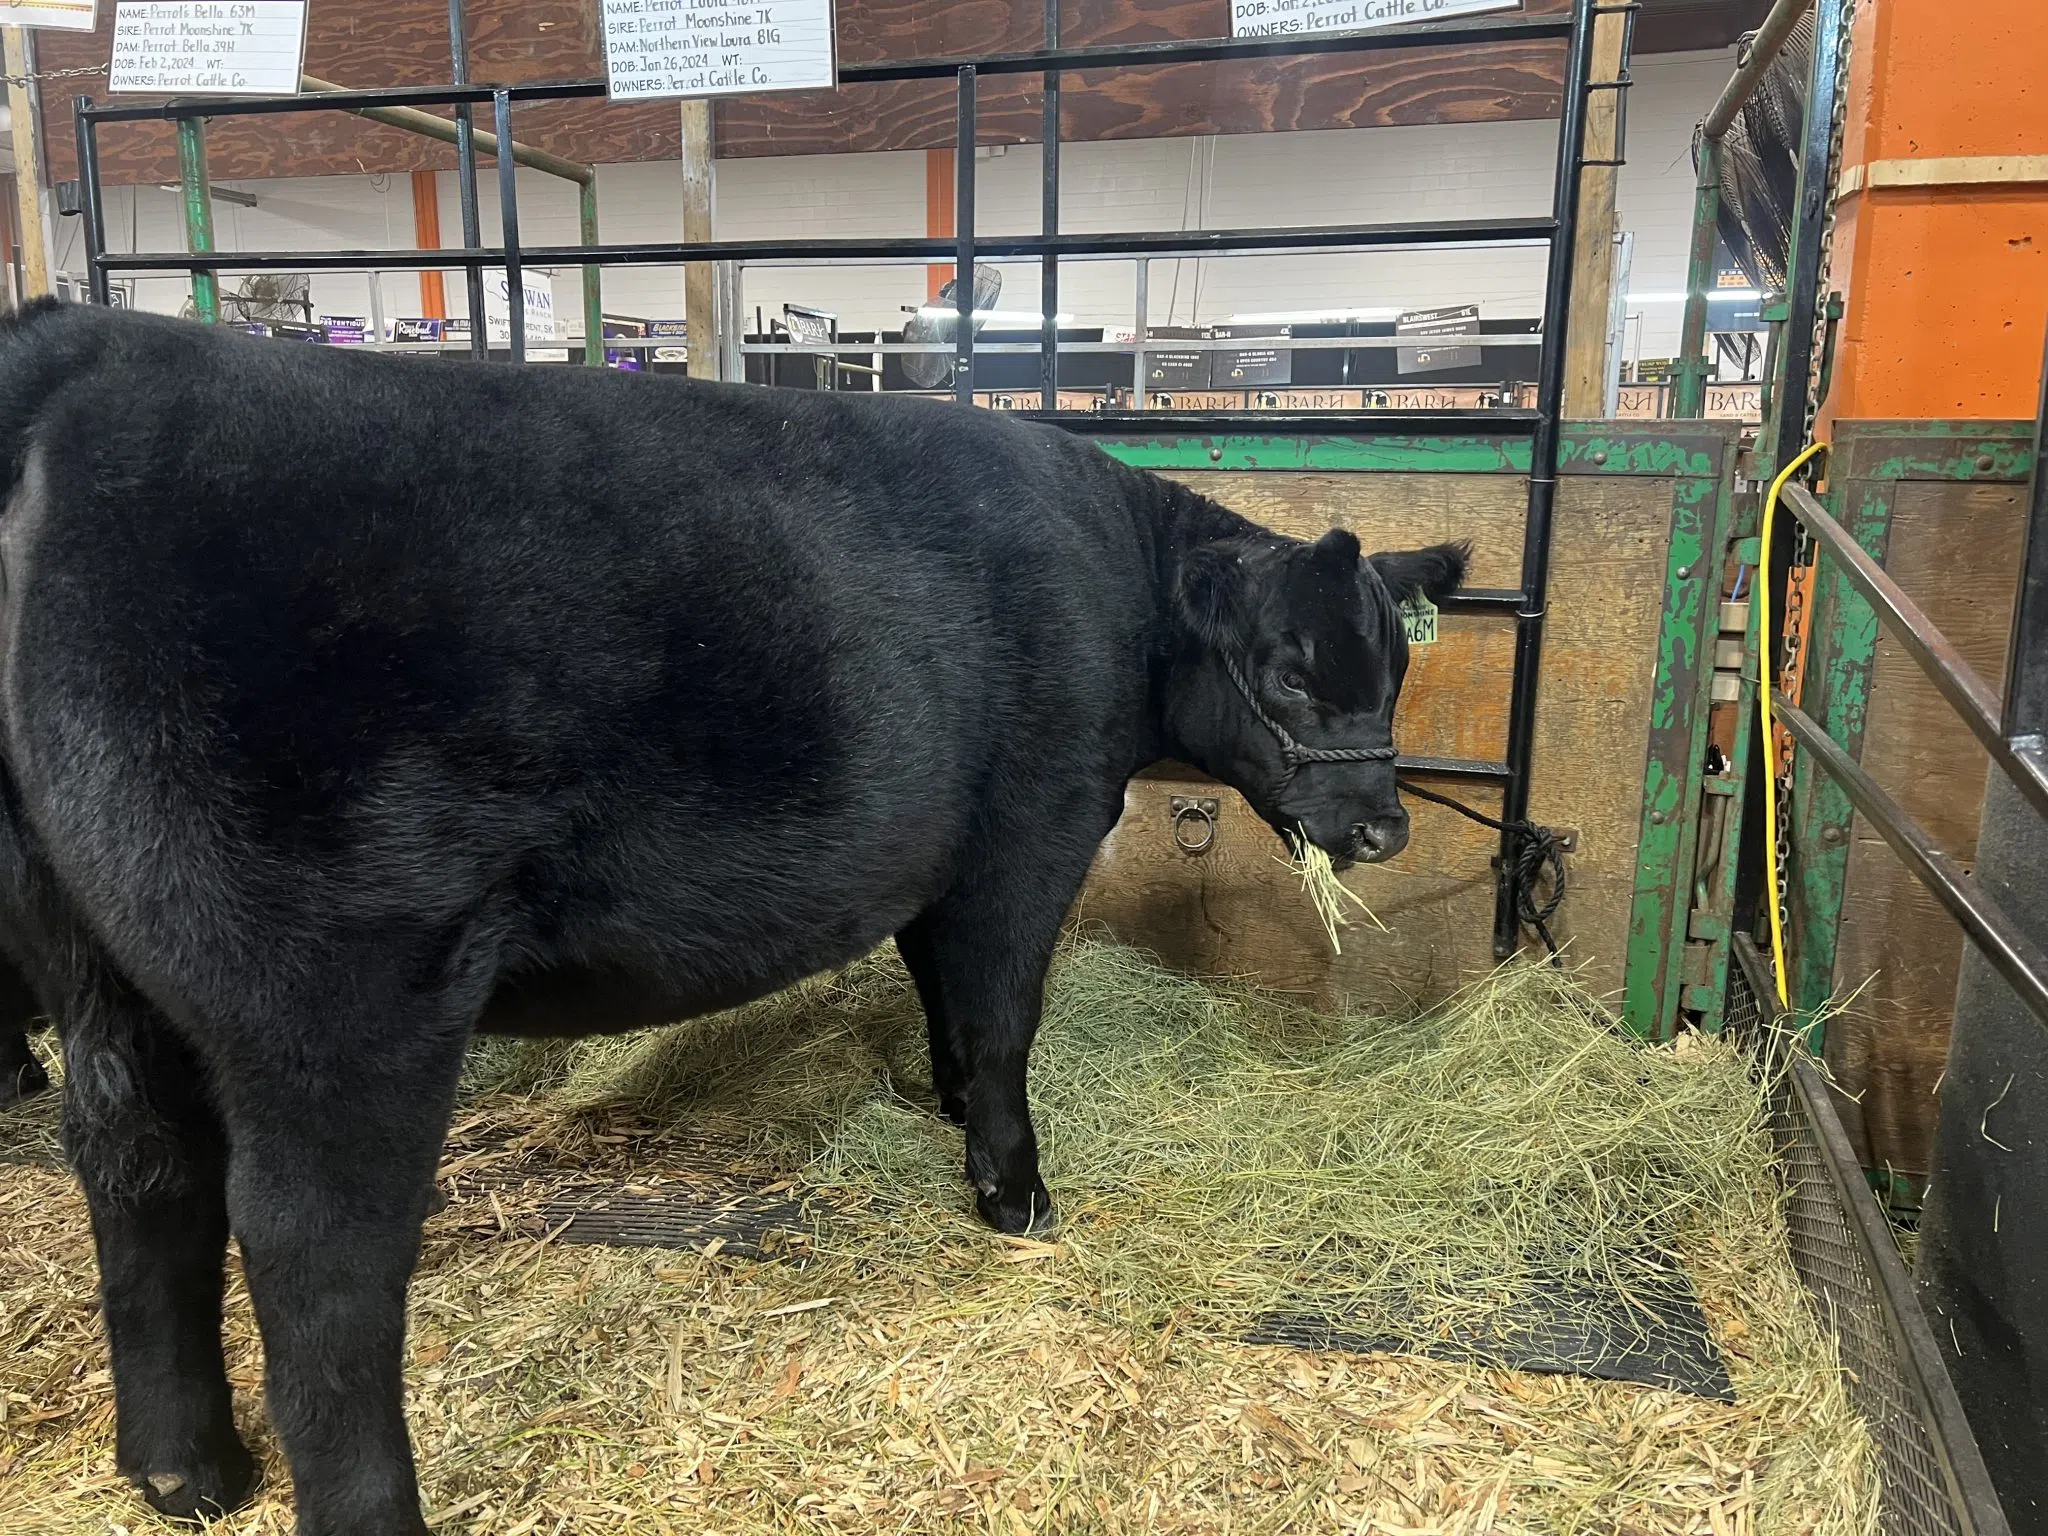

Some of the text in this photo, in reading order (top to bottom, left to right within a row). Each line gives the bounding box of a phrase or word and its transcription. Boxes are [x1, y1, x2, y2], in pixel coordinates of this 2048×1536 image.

[118, 9, 148, 18] NAME:
[194, 4, 223, 18] Bella
[230, 4, 256, 18] 63M
[606, 2, 644, 14] NAME:
[1236, 3, 1270, 18] DOB:
[117, 26, 142, 36] SIRE:
[144, 22, 176, 36] Perrot
[180, 23, 234, 36] Moonshine
[608, 9, 772, 34] SIRE: Perrot Moonshine 7K
[1236, 20, 1303, 38] OWNERS:
[1306, 6, 1358, 30] Perrot
[1364, 0, 1415, 20] Cattle
[116, 40, 234, 52] DAM: Perrot Bella 39H
[609, 42, 639, 54] DAM:
[639, 36, 690, 53] Northern
[692, 34, 718, 49] View
[114, 56, 224, 70] DOB: Feb 2,2024 WT:
[611, 62, 638, 74] DOB:
[663, 53, 708, 73] 26,2024
[722, 54, 742, 66] WT:
[112, 72, 248, 86] OWNERS: Perrot Cattle Co.
[613, 67, 772, 93] OWNERS: Perrot Cattle Co.
[500, 280, 551, 309] SWAN
[1617, 392, 1653, 412] R-H
[1710, 392, 1762, 412] BAR-
